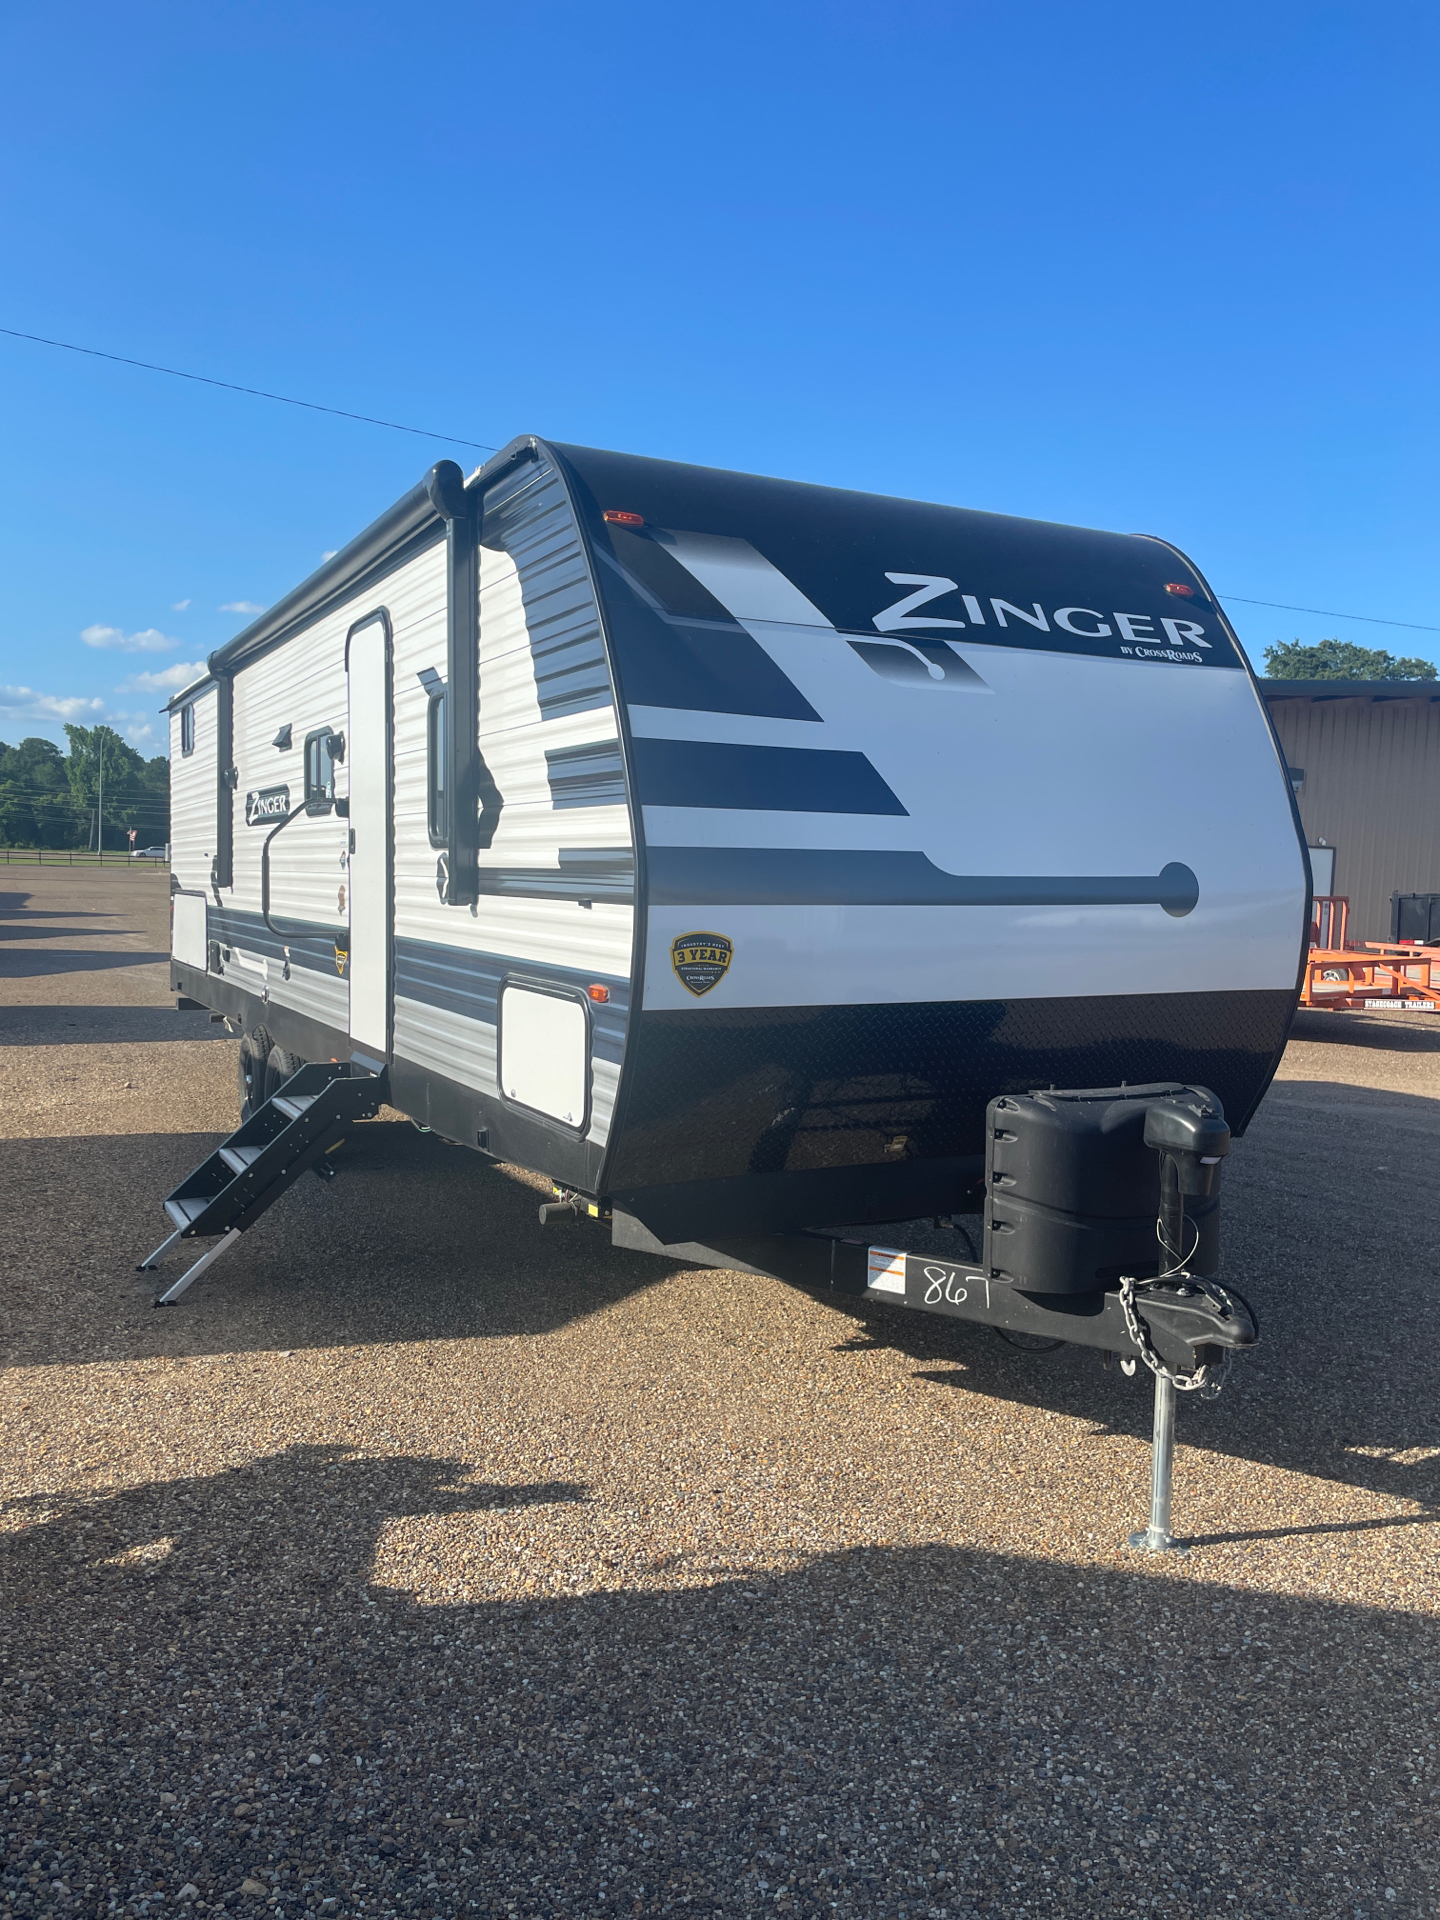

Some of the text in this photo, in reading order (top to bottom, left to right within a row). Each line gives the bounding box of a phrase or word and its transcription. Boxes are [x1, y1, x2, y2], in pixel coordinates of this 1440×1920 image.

[872, 571, 1212, 648] ZINGER
[1120, 646, 1134, 655] BY
[248, 791, 286, 825] ZINGER
[677, 949, 728, 963] 3 YEAR
[923, 1266, 990, 1309] 867
